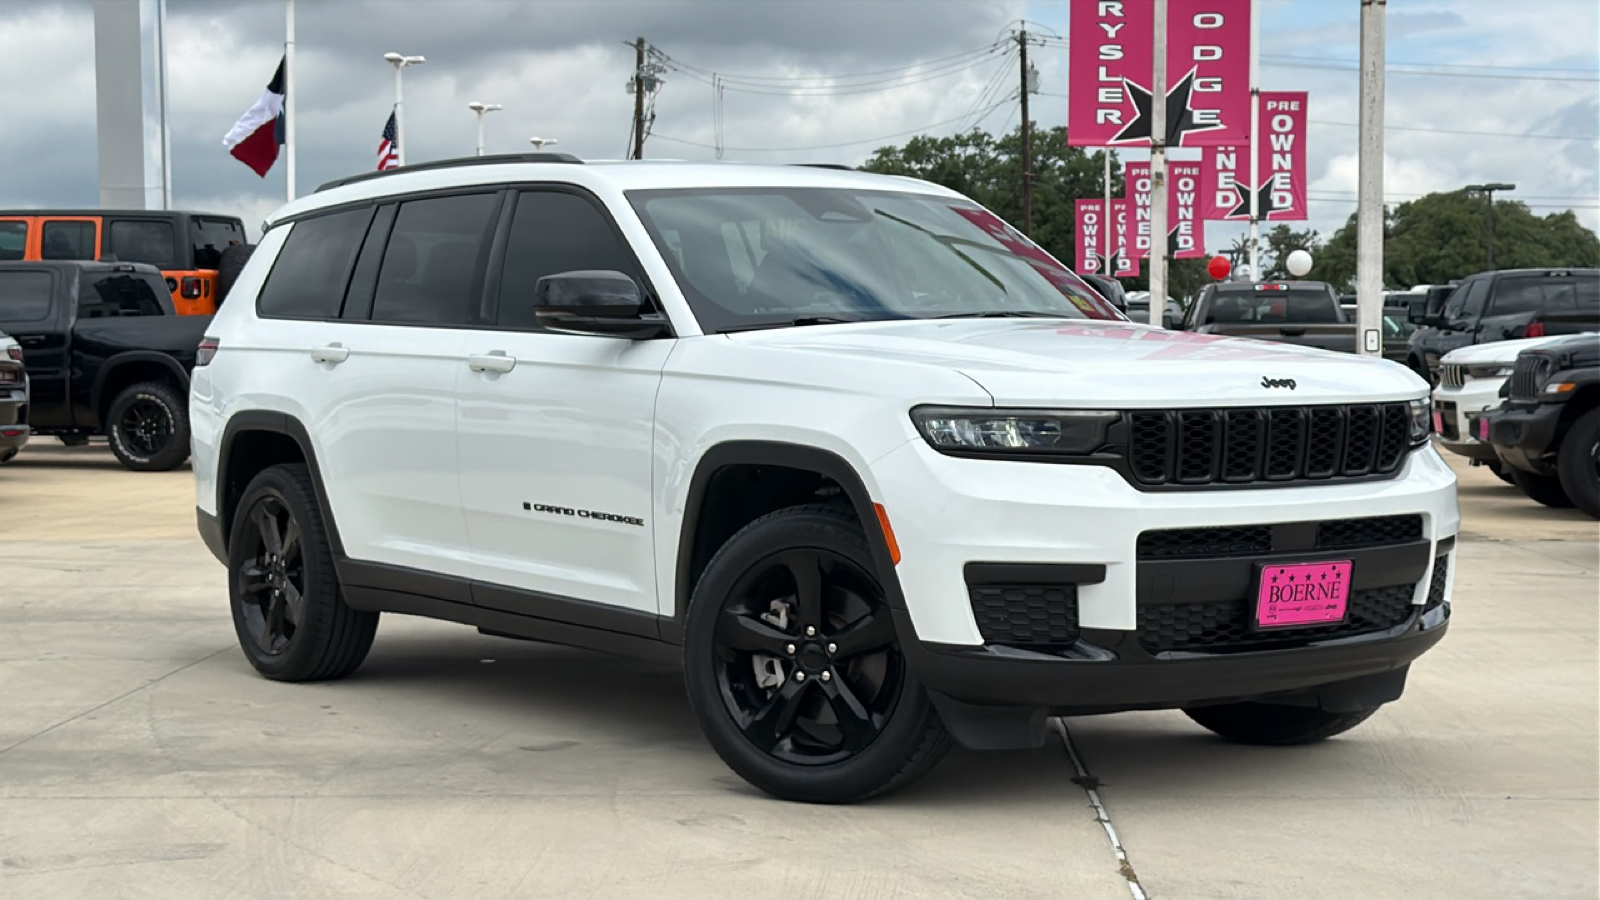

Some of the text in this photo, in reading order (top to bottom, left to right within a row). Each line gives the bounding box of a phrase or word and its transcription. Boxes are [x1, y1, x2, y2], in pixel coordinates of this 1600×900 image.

[1192, 13, 1225, 125] ODGE
[1266, 101, 1300, 111] PRE
[1174, 167, 1199, 175] PRE
[1215, 146, 1237, 208] NED
[1269, 114, 1295, 208] OWNED
[1083, 213, 1098, 270] OWNED
[1134, 179, 1151, 249] OWNED
[1176, 178, 1196, 249] OWNED
[1260, 375, 1297, 390] Jeep
[533, 503, 644, 526] GRAND CHEROKEE
[1269, 581, 1341, 603] BOERNE
